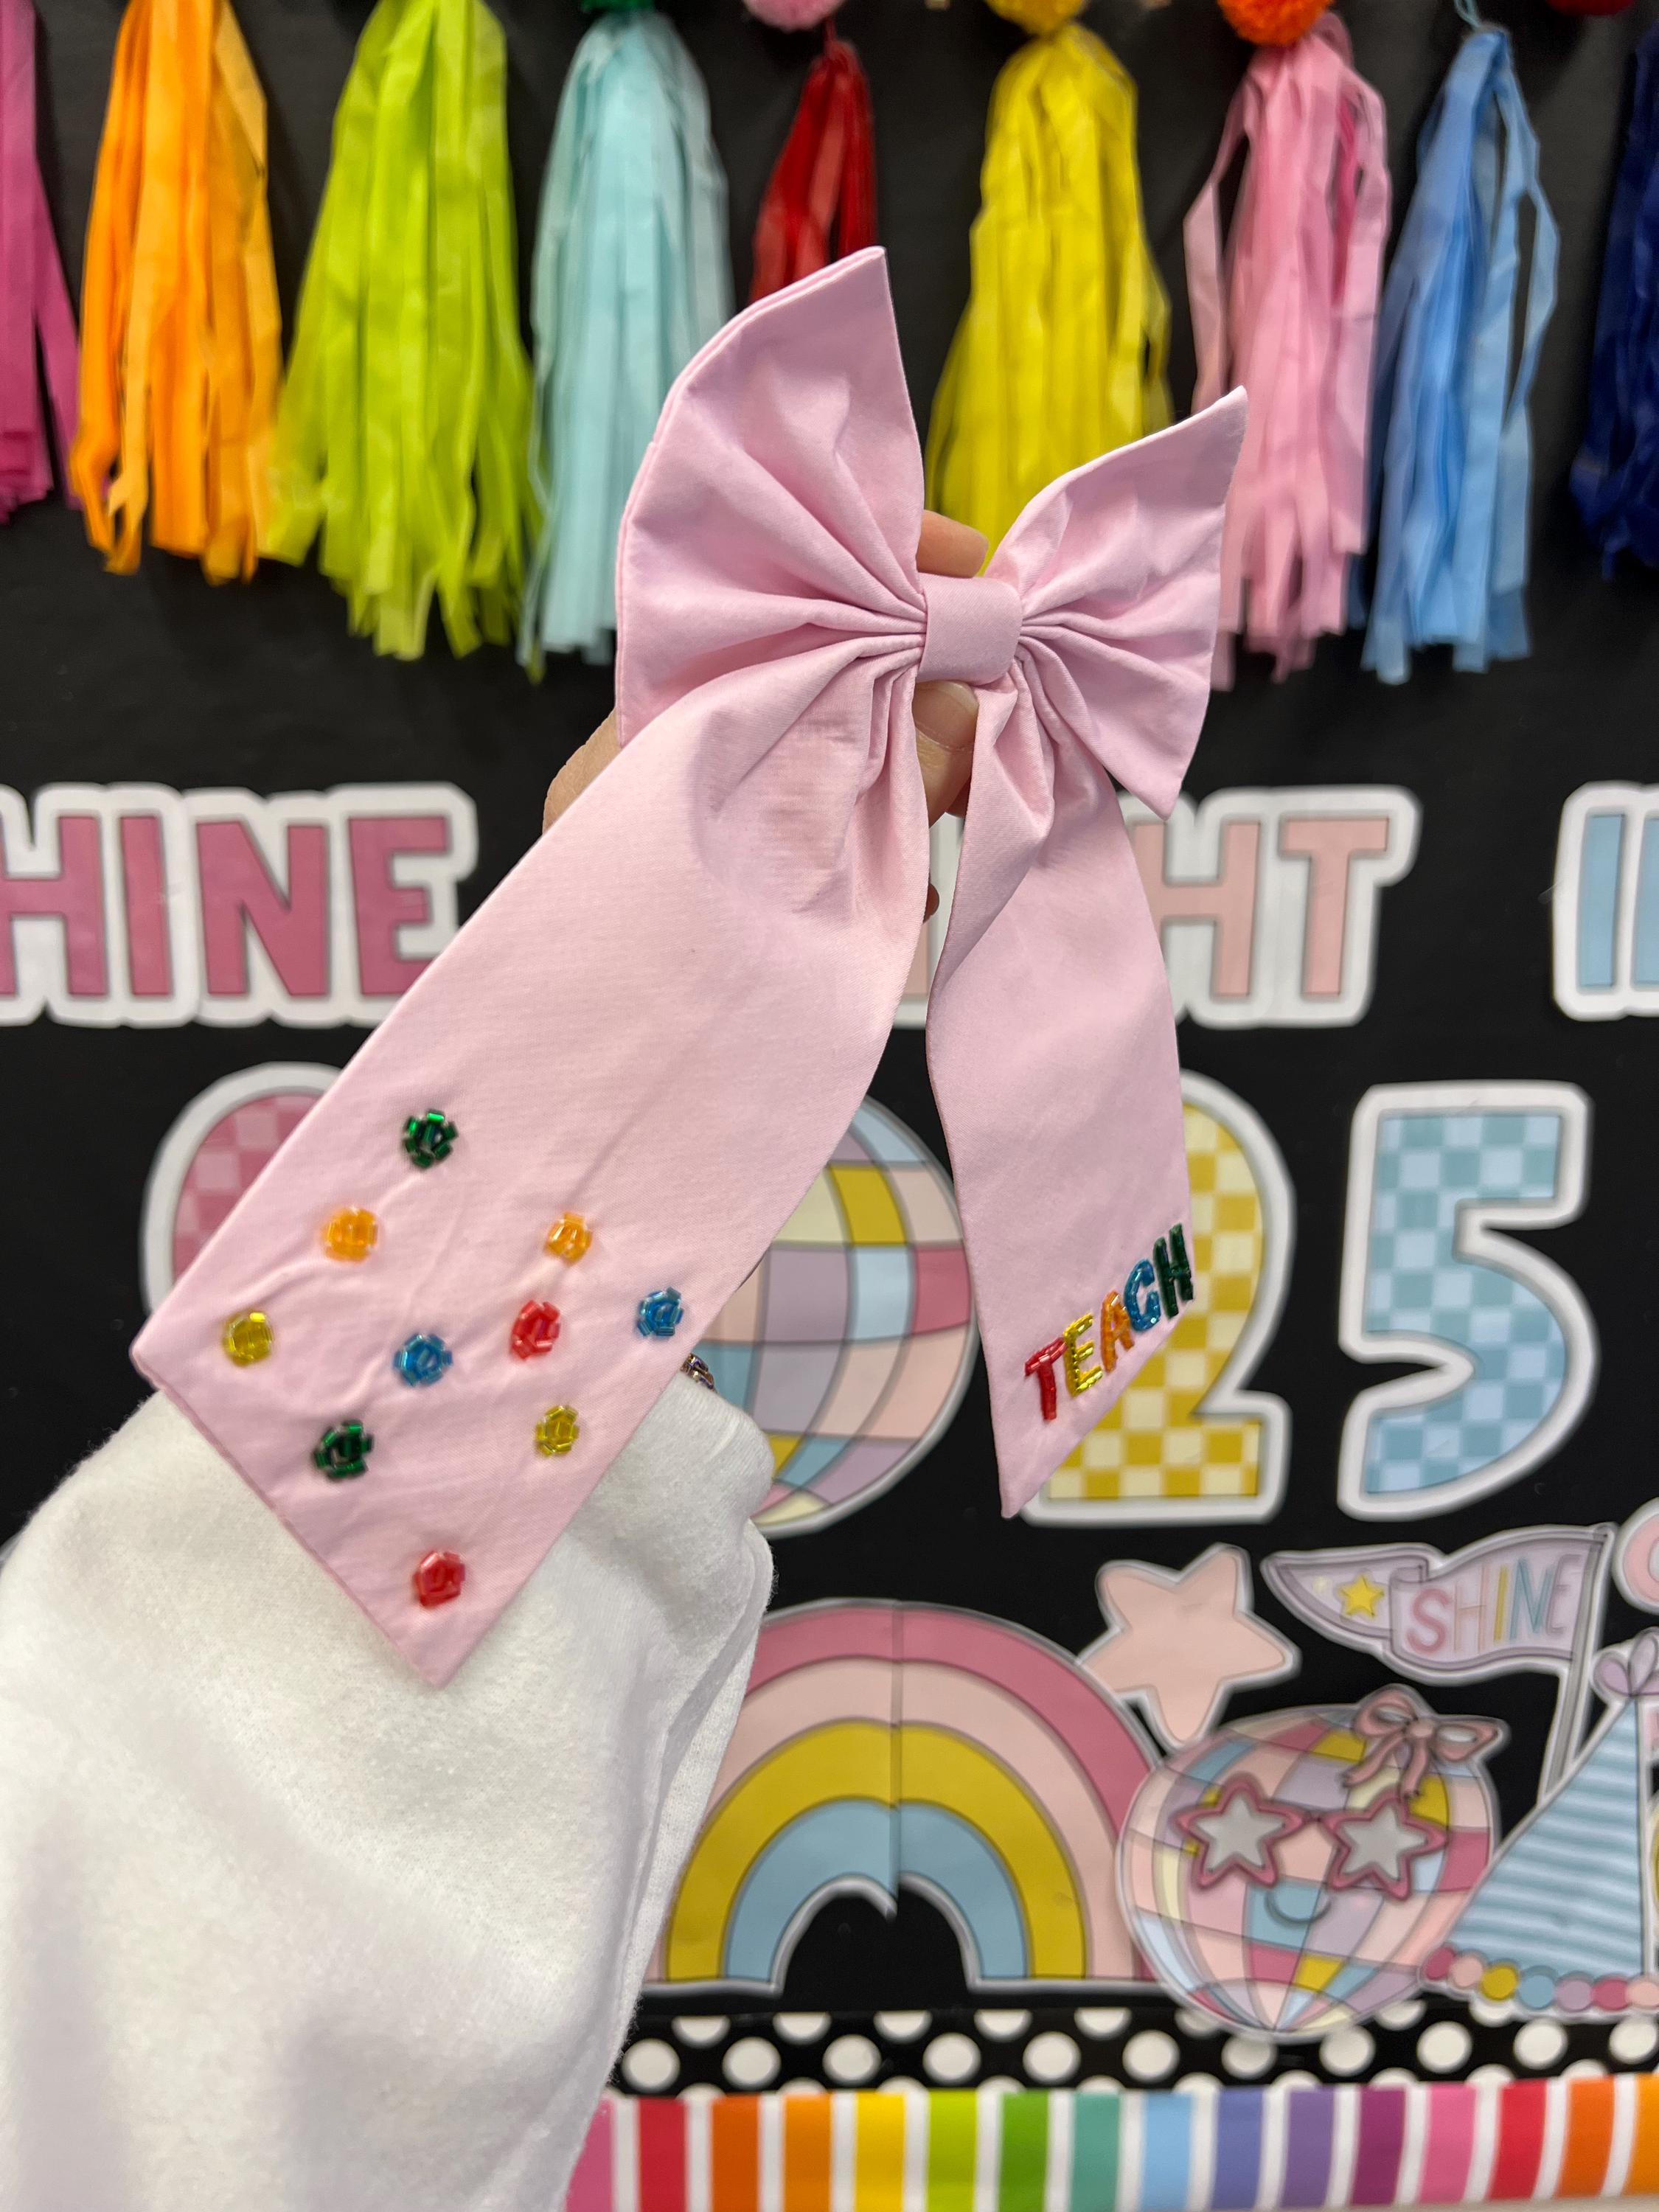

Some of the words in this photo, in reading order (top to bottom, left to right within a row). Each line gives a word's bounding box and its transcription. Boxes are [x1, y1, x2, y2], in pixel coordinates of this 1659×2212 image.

[1130, 817, 1391, 997] HT
[1024, 1222, 1194, 1422] TEACH
[1406, 1553, 1583, 1654] SHINE
